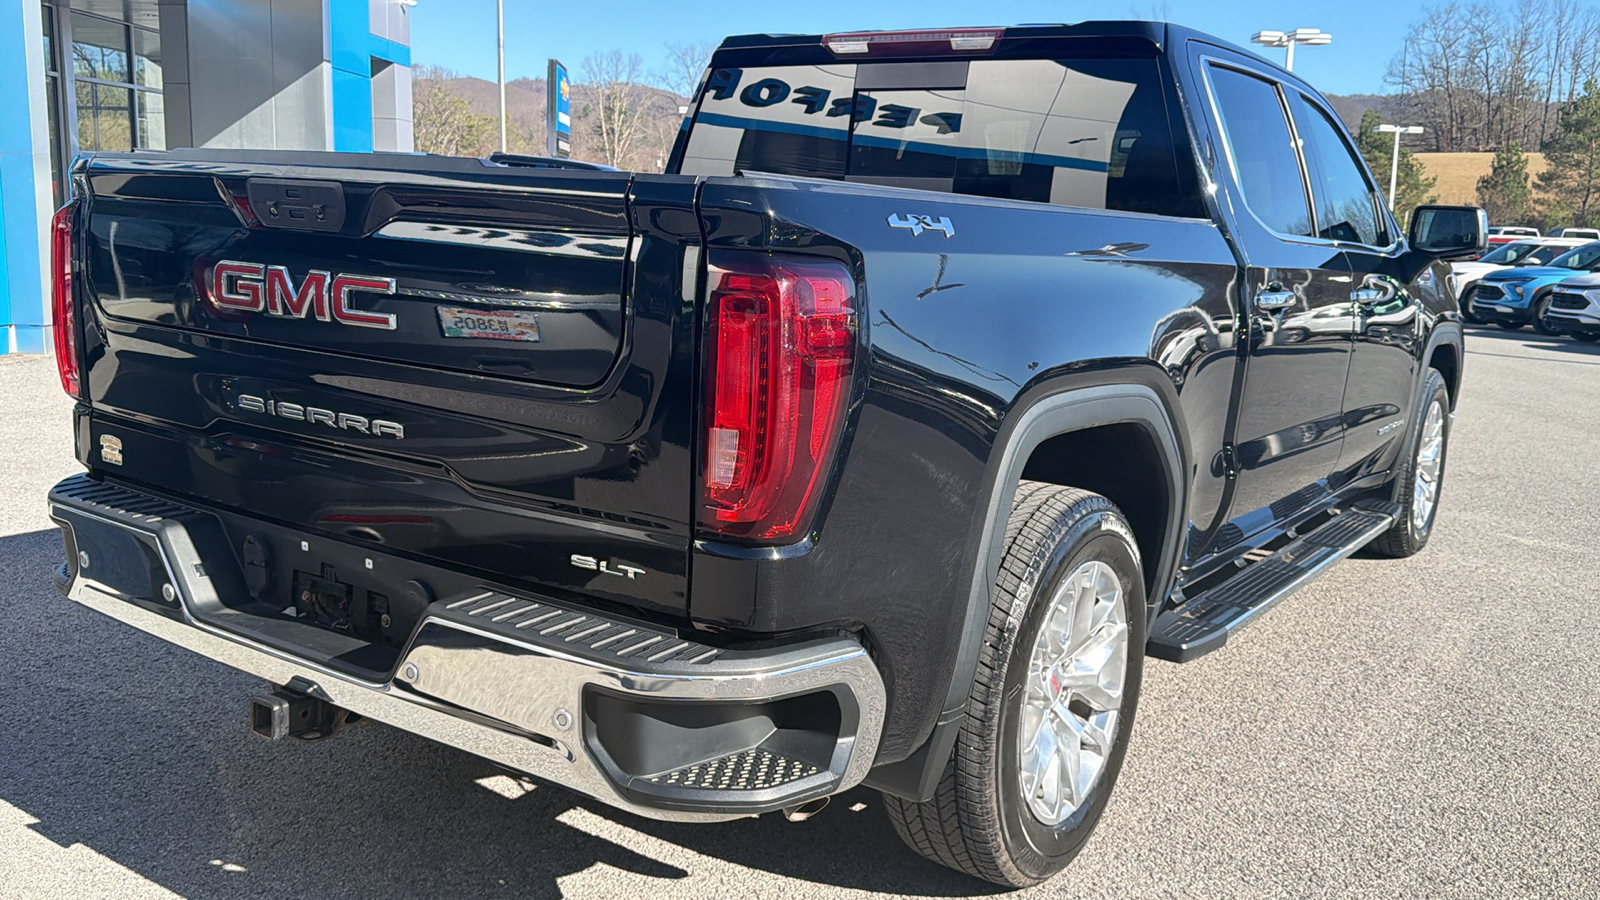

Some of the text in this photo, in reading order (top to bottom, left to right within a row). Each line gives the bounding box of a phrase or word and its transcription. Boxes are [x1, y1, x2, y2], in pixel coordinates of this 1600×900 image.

[213, 259, 397, 331] GMC
[238, 394, 405, 440] SIERRA
[571, 554, 646, 580] SLT
